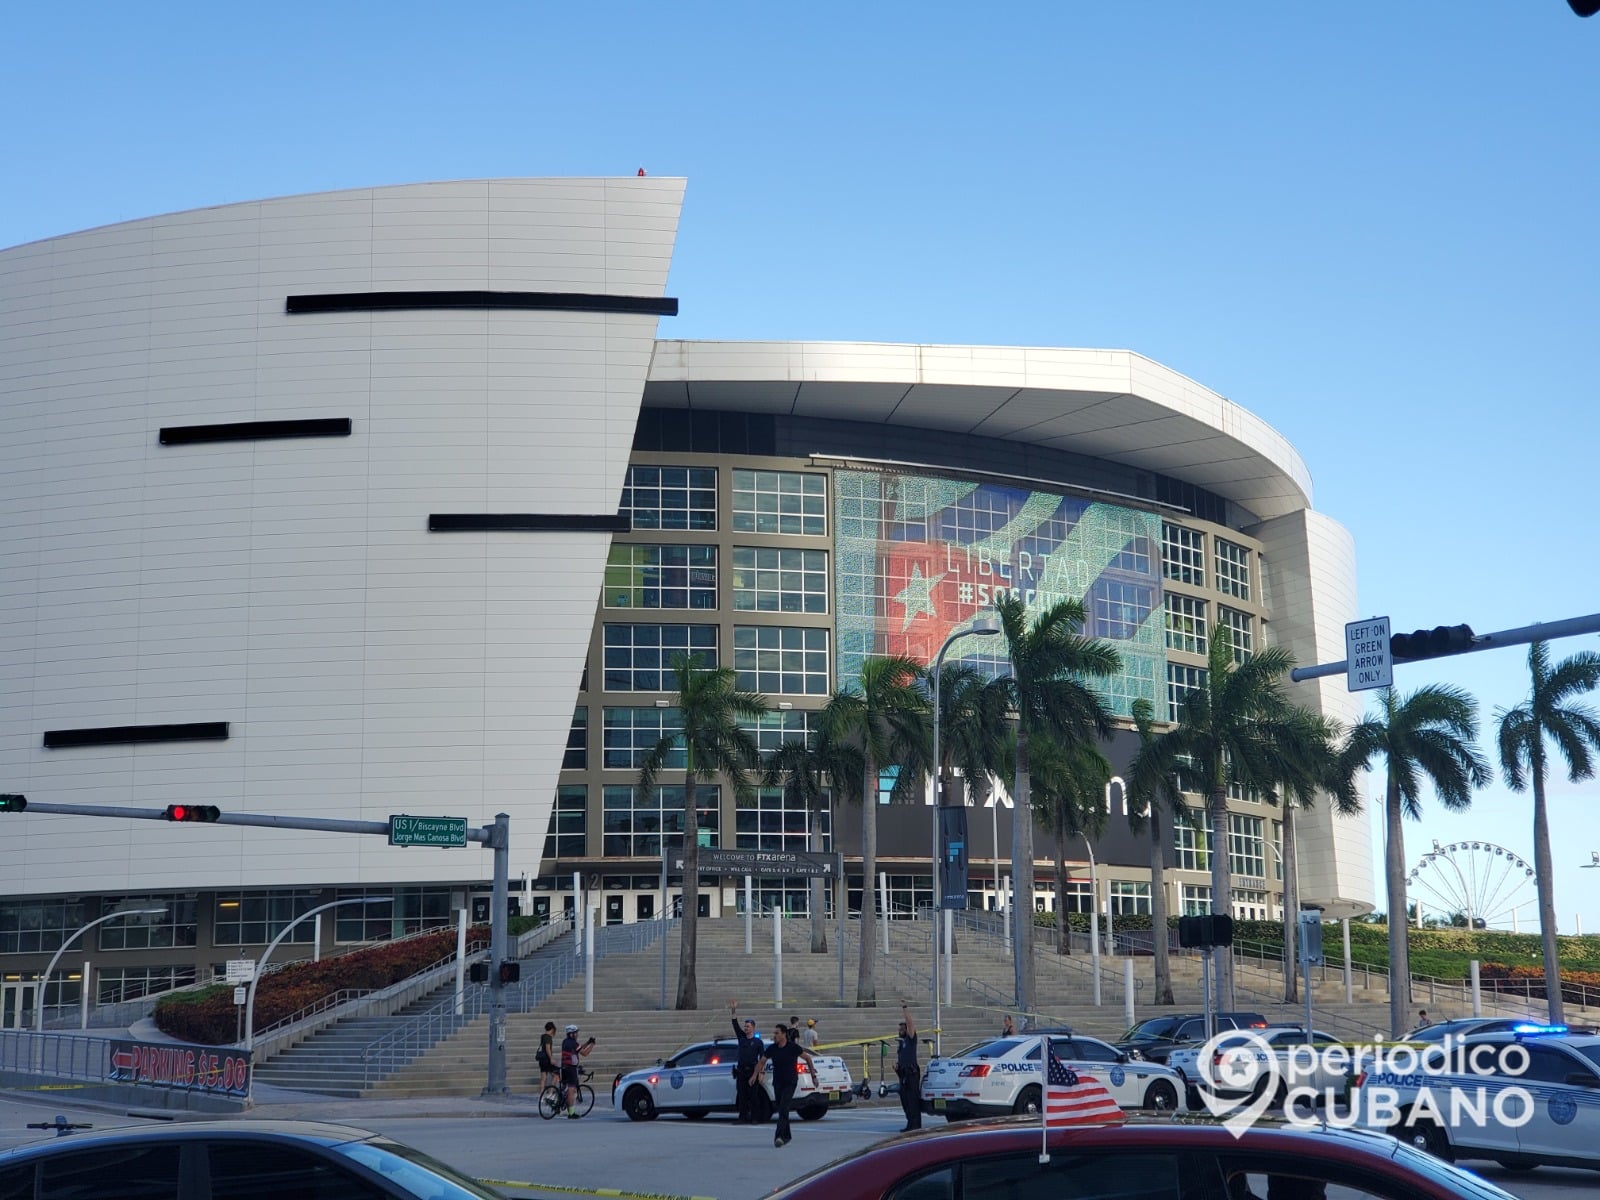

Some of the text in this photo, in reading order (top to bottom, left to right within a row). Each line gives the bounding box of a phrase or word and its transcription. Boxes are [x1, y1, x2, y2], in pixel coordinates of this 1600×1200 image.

[947, 542, 1089, 588] LIBERTAD
[1350, 624, 1386, 640] LEFT ON
[1355, 640, 1383, 654] GREEN
[1355, 654, 1384, 669] ARROW
[1358, 670, 1381, 683] ONLY
[395, 819, 407, 830] US
[449, 823, 464, 832] Blvd
[394, 833, 464, 843] Jorge Mas Canosa Blvd
[713, 853, 745, 861] WELCOME
[590, 873, 600, 889] 2
[132, 1045, 247, 1090] PARKING $5.00
[1001, 1063, 1035, 1072] POLICE
[1377, 1072, 1423, 1087] POLICE
